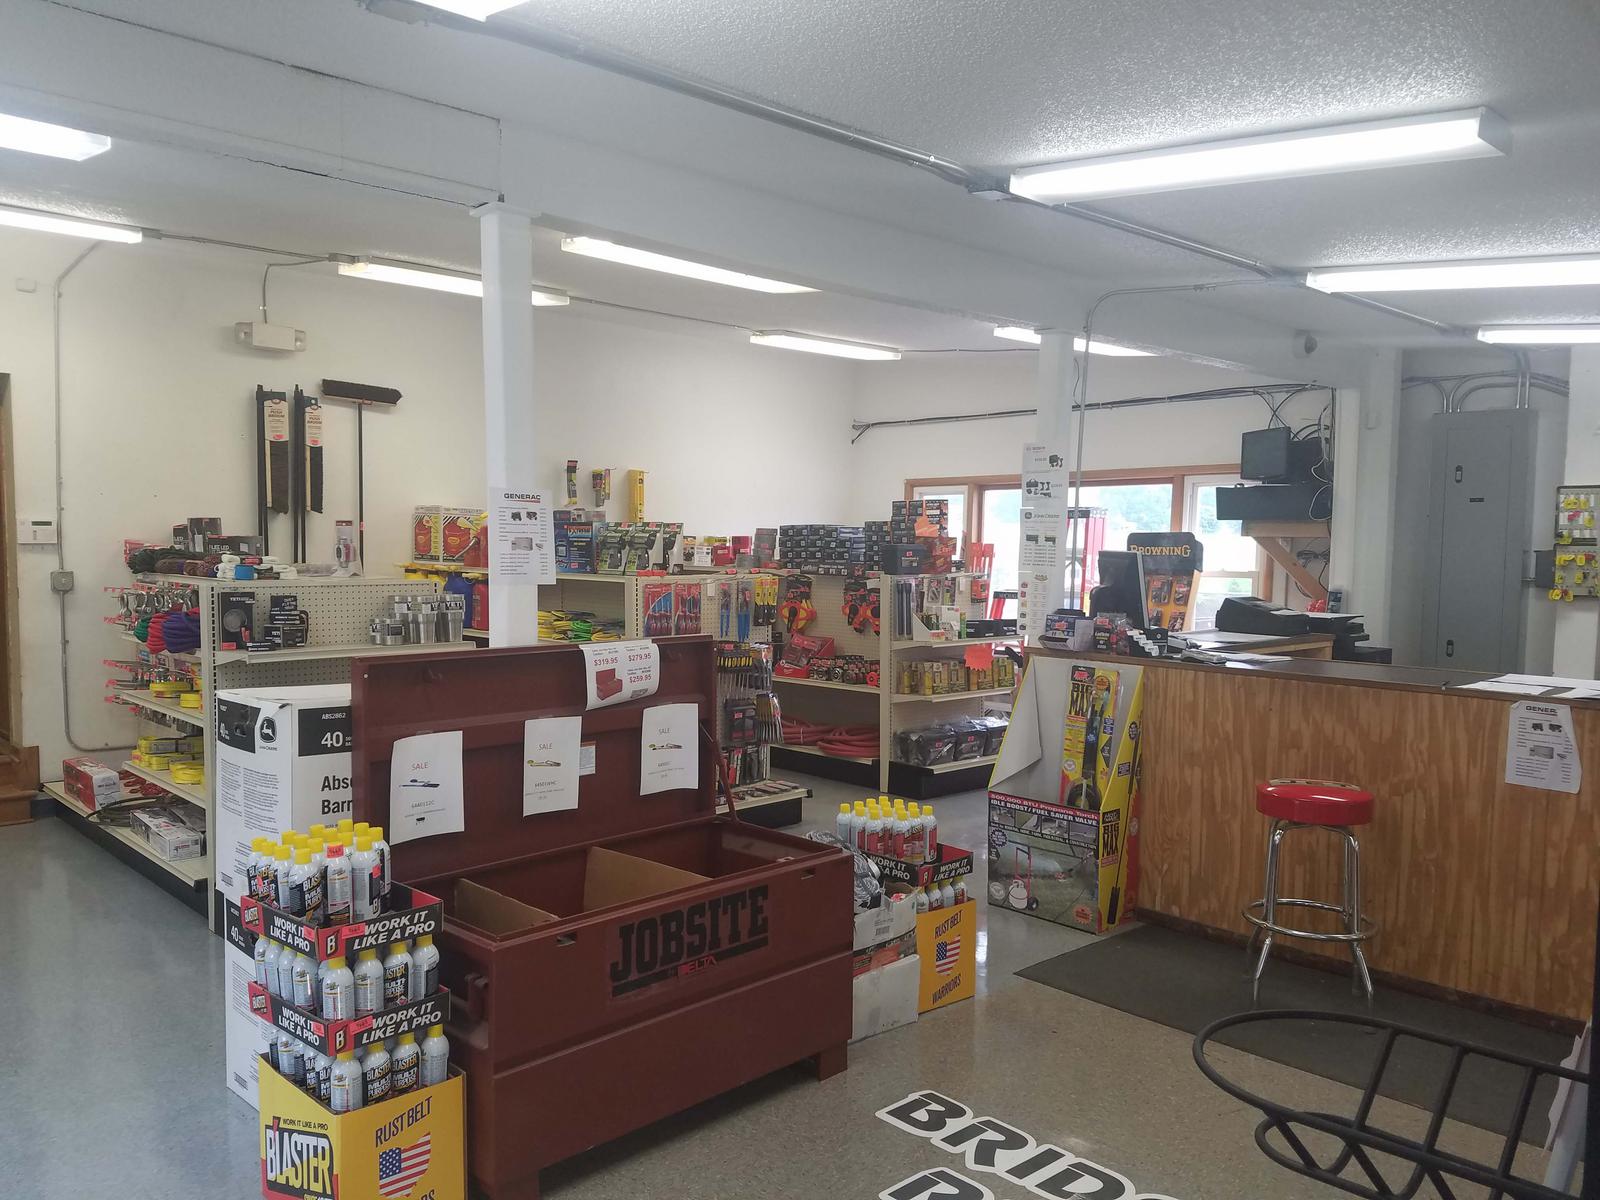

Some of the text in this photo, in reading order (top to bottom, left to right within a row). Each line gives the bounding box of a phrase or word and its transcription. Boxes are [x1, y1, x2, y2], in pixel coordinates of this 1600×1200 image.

[503, 492, 541, 500] GENERAC
[1129, 544, 1192, 558] BROWNING
[593, 657, 618, 667] $319.95
[628, 653, 652, 662] $279.95
[629, 674, 652, 684] $259.95
[1071, 682, 1092, 694] BIG
[321, 731, 344, 748] 40
[657, 727, 671, 735] SALE
[538, 743, 553, 751] SALE
[411, 761, 429, 771] SALE
[990, 799, 1006, 807] IDLE
[1032, 808, 1049, 817] FUEL
[1050, 812, 1074, 821] SAVER
[1075, 816, 1098, 826] VALVE
[1023, 800, 1039, 809] BTU
[1040, 804, 1074, 815] Propane
[1076, 811, 1098, 820] Torch
[1102, 822, 1119, 835] BIG
[1102, 832, 1119, 858] MAX
[870, 855, 906, 871] WORK IT
[940, 858, 968, 873] WORK IT
[892, 869, 911, 880] PRO
[934, 871, 950, 882] LIKE
[955, 865, 971, 877] PRO
[273, 915, 305, 938] WORK IT
[365, 914, 413, 936] WORK
[413, 910, 429, 924] IT
[934, 909, 963, 940] RUST BELT
[270, 926, 310, 952] LIKE A PRO
[353, 931, 388, 950] LIKE
[390, 931, 402, 941] A
[404, 920, 436, 938] PRO
[609, 884, 769, 983] JOBSITE
[932, 972, 962, 1005] WARRIORS
[282, 1006, 314, 1032] WORK IT
[372, 1001, 435, 1029] WORK IT
[279, 1015, 320, 1046] LIKE A PRO
[362, 1010, 442, 1045] LIKE A PRO
[282, 1118, 296, 1126] WORK
[302, 1121, 312, 1129] LIKE
[317, 1123, 329, 1131] PRO
[375, 1096, 433, 1148] RUST BELT
[878, 1091, 1175, 1200] BRID
